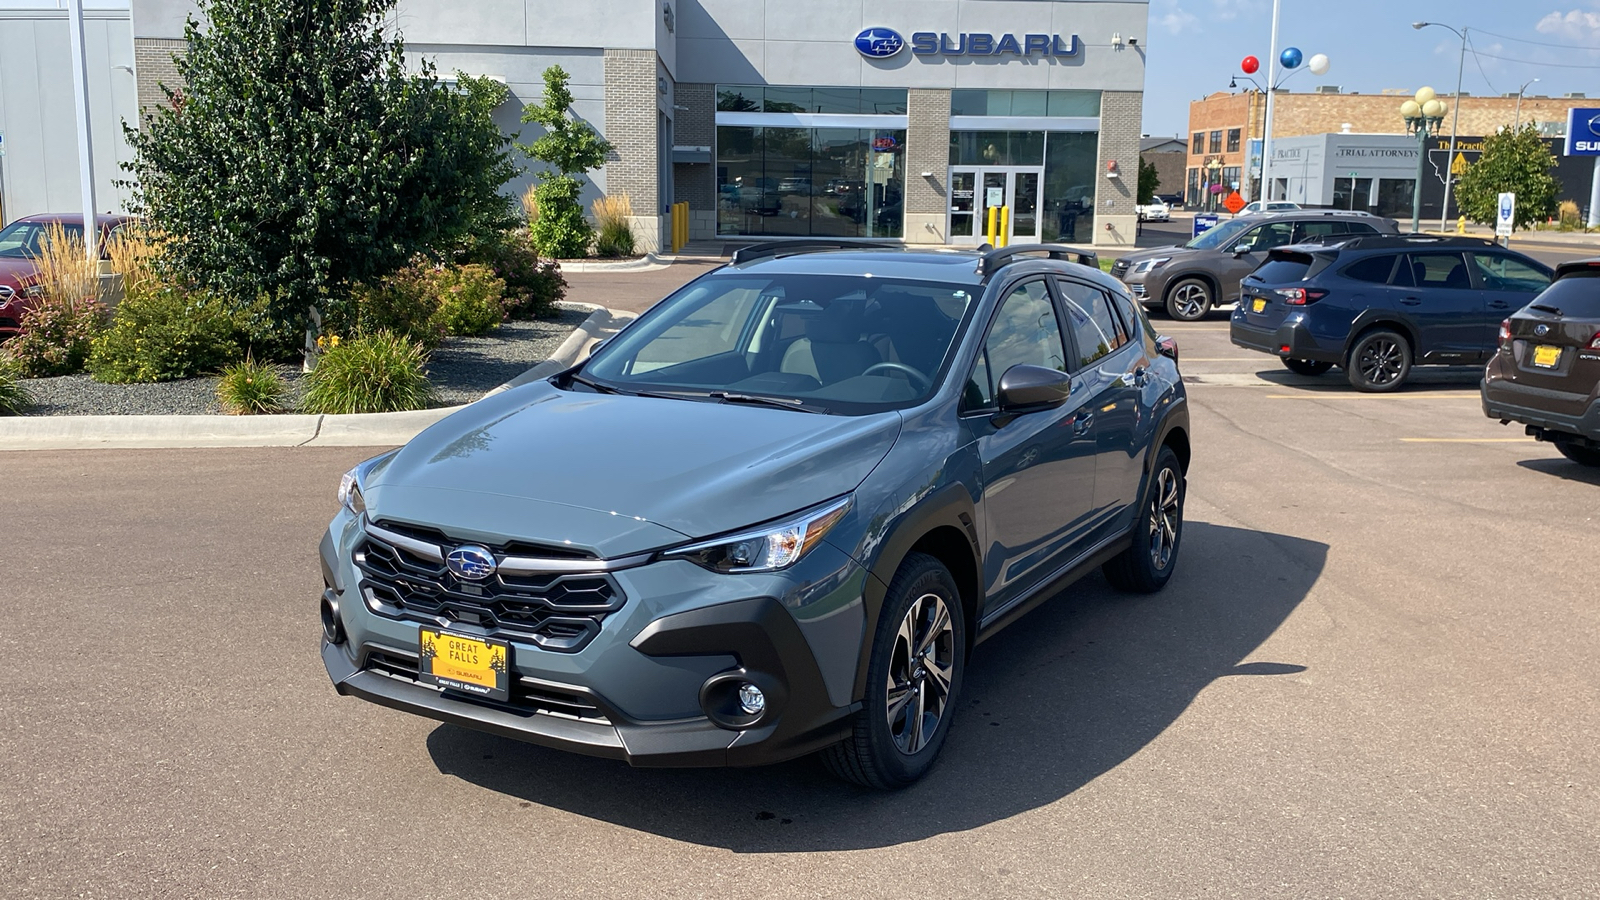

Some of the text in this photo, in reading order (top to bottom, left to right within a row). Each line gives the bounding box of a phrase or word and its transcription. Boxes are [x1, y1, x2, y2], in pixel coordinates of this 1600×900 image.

[912, 32, 1079, 56] SUBARU
[1438, 141, 1450, 149] Th
[1575, 141, 1600, 151] SU
[1277, 149, 1301, 158] PRACTICE
[1340, 149, 1419, 157] TRIAL ATTORNEYS
[449, 640, 478, 654] GREAT
[449, 651, 479, 664] FALLS
[456, 670, 483, 680] SUBARU
